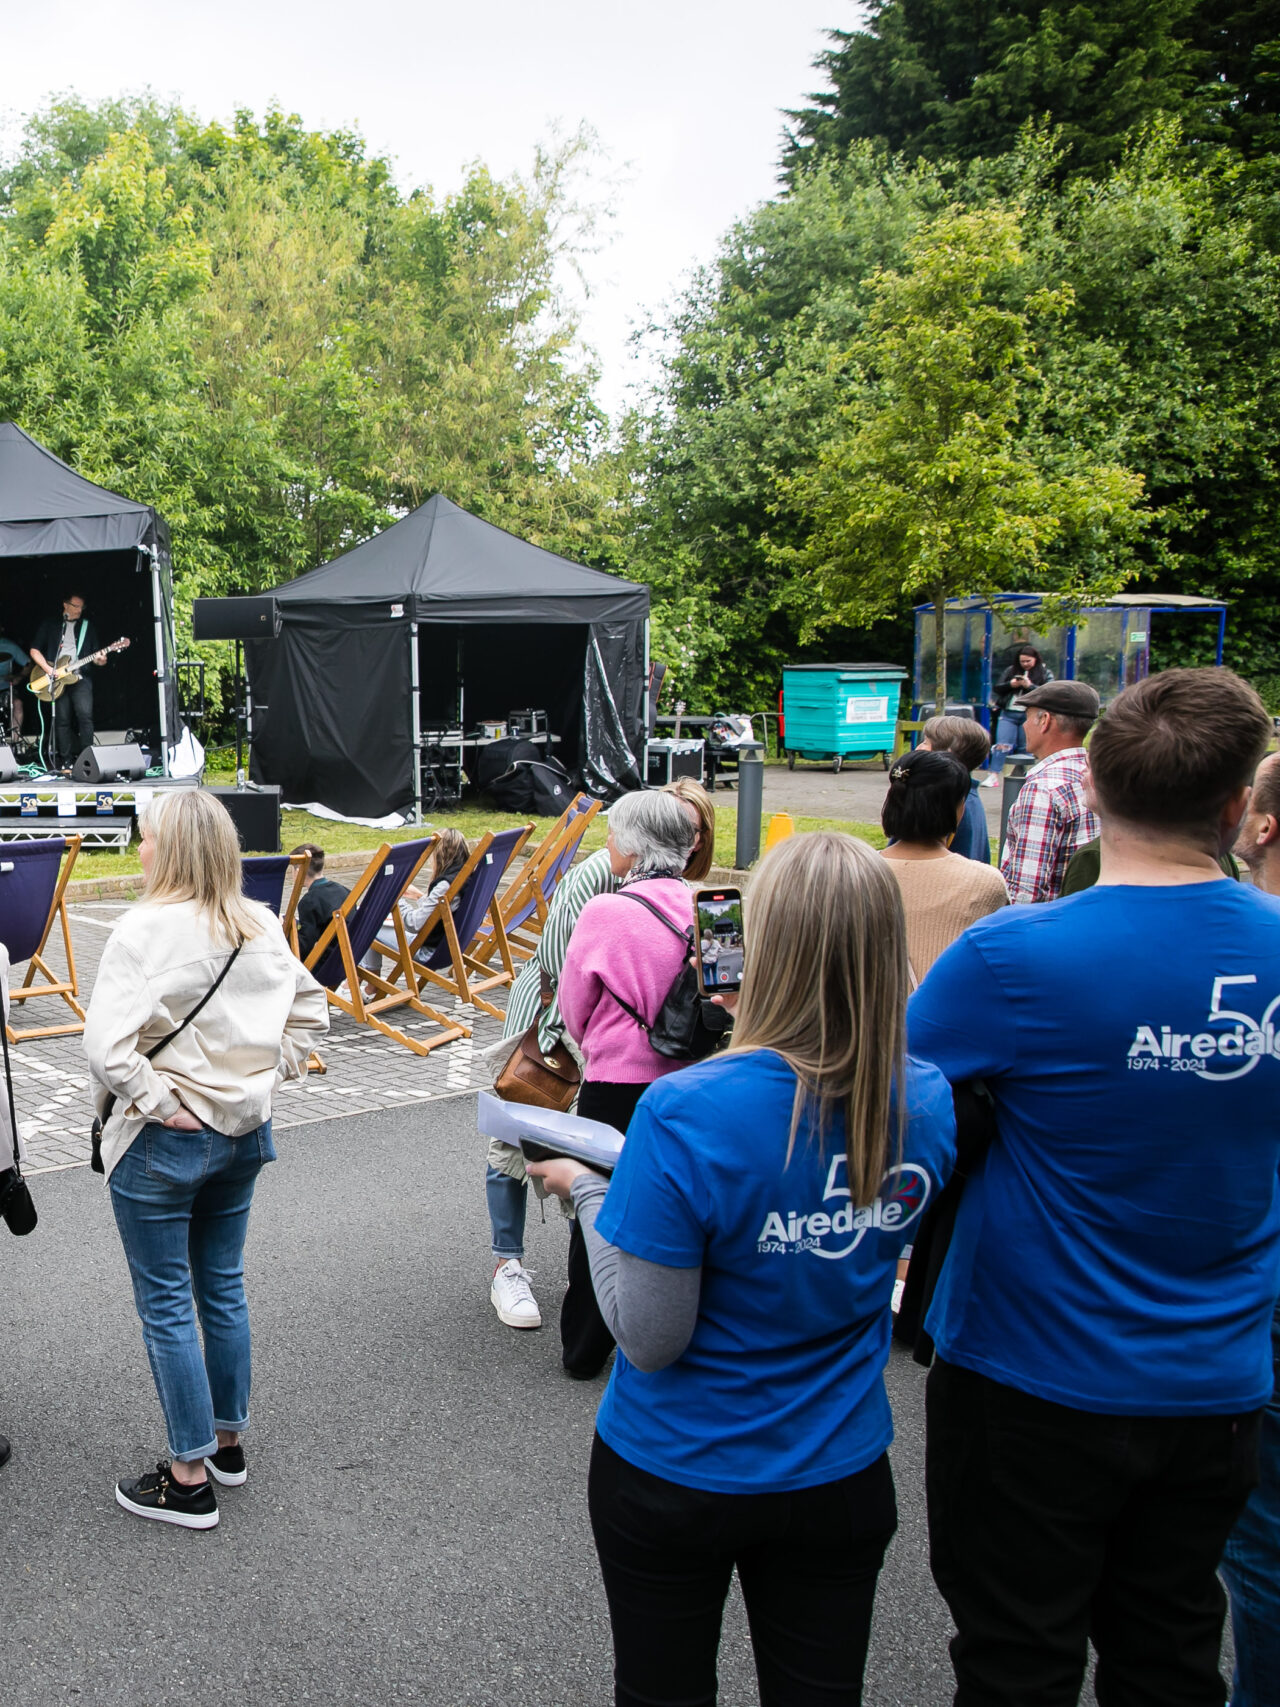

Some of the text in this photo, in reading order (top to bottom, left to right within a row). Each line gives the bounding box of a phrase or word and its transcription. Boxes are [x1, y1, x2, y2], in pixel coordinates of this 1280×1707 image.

[22, 796, 37, 809] 50
[98, 794, 112, 807] 50
[1127, 1021, 1280, 1058] Airedal
[1195, 974, 1280, 1081] 5
[757, 1197, 903, 1242] Airedale
